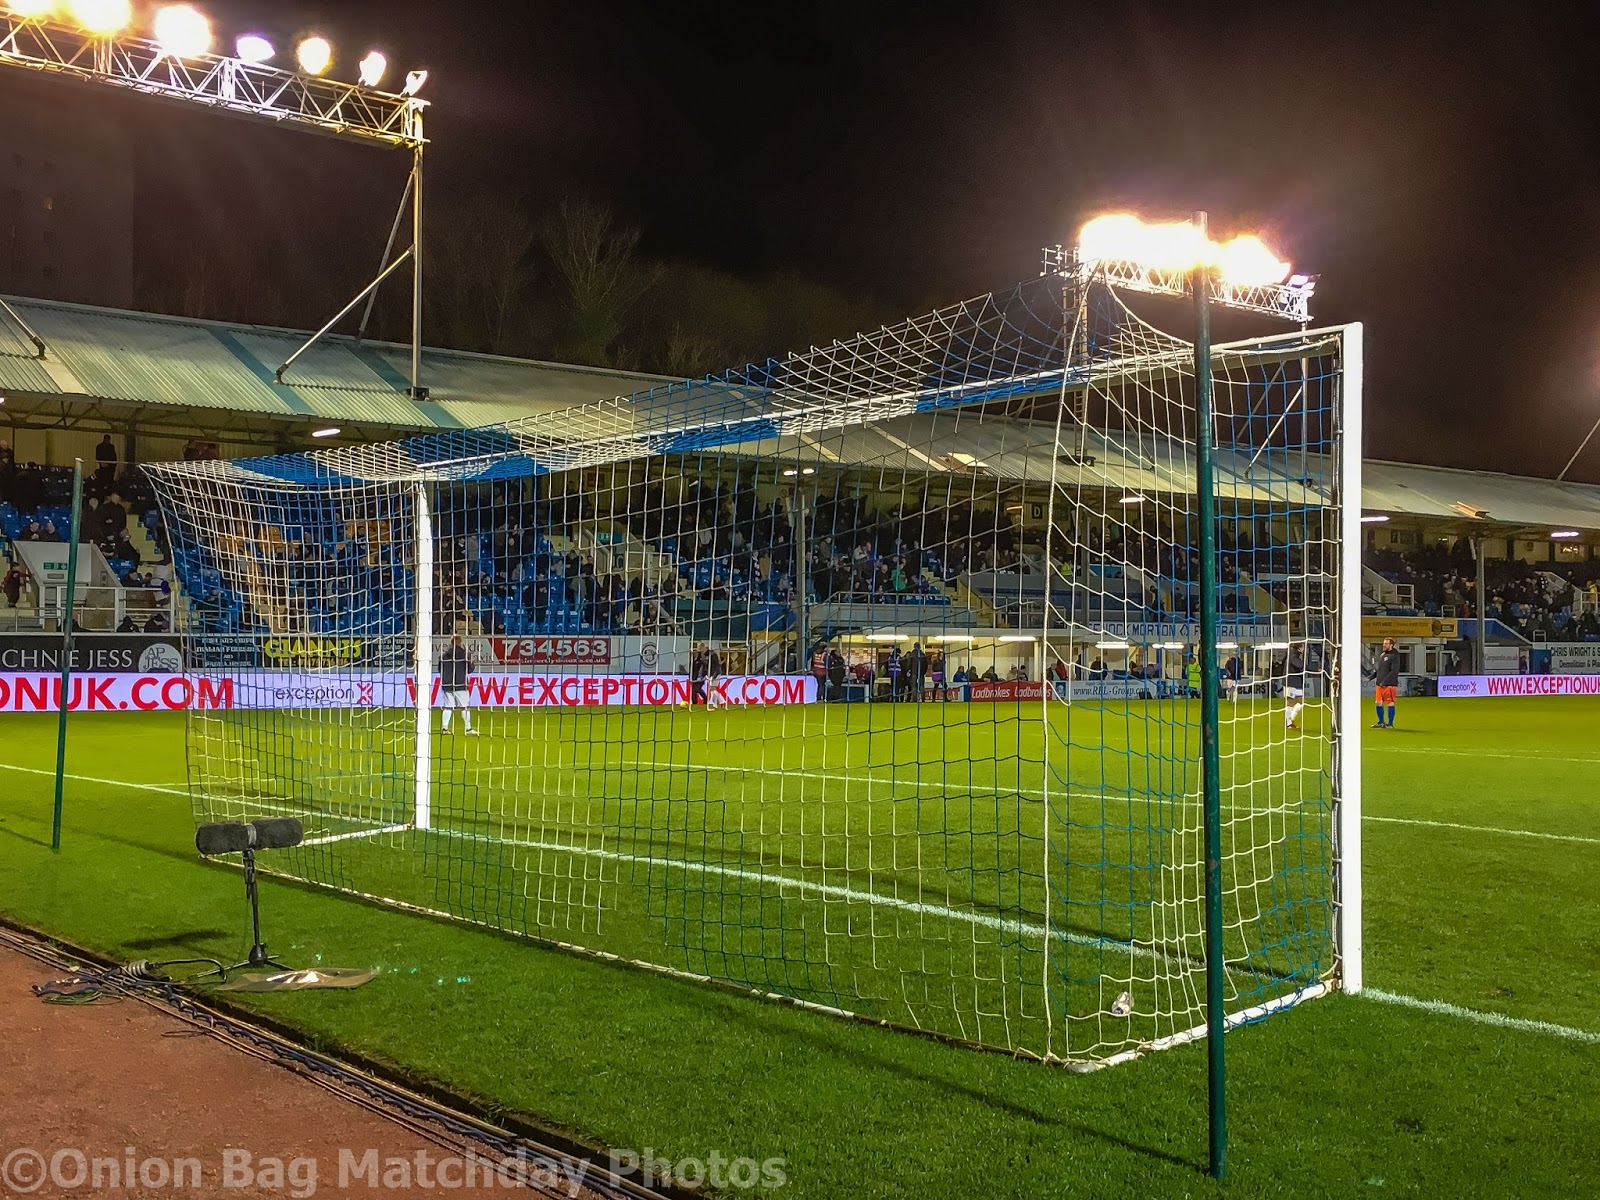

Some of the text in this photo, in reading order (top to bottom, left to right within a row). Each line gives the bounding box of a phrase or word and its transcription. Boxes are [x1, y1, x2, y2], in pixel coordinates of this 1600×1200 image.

[1033, 506, 1041, 517] D
[1133, 623, 1175, 636] MORTON
[1194, 625, 1247, 637] FTBALL
[147, 648, 166, 658] AP
[265, 639, 361, 658] GIANNIS
[502, 640, 606, 656] 734563
[1551, 647, 1567, 656] CHRIS
[1569, 647, 1590, 656] WRIGHT
[86, 649, 132, 670] JESS
[143, 658, 179, 669] JESS
[971, 687, 1010, 699] Ladbrokes
[1014, 686, 1052, 697] Ladbroks
[1237, 684, 1266, 694] BLAIRS
[1442, 682, 1470, 693] exception
[275, 687, 354, 703] exception
